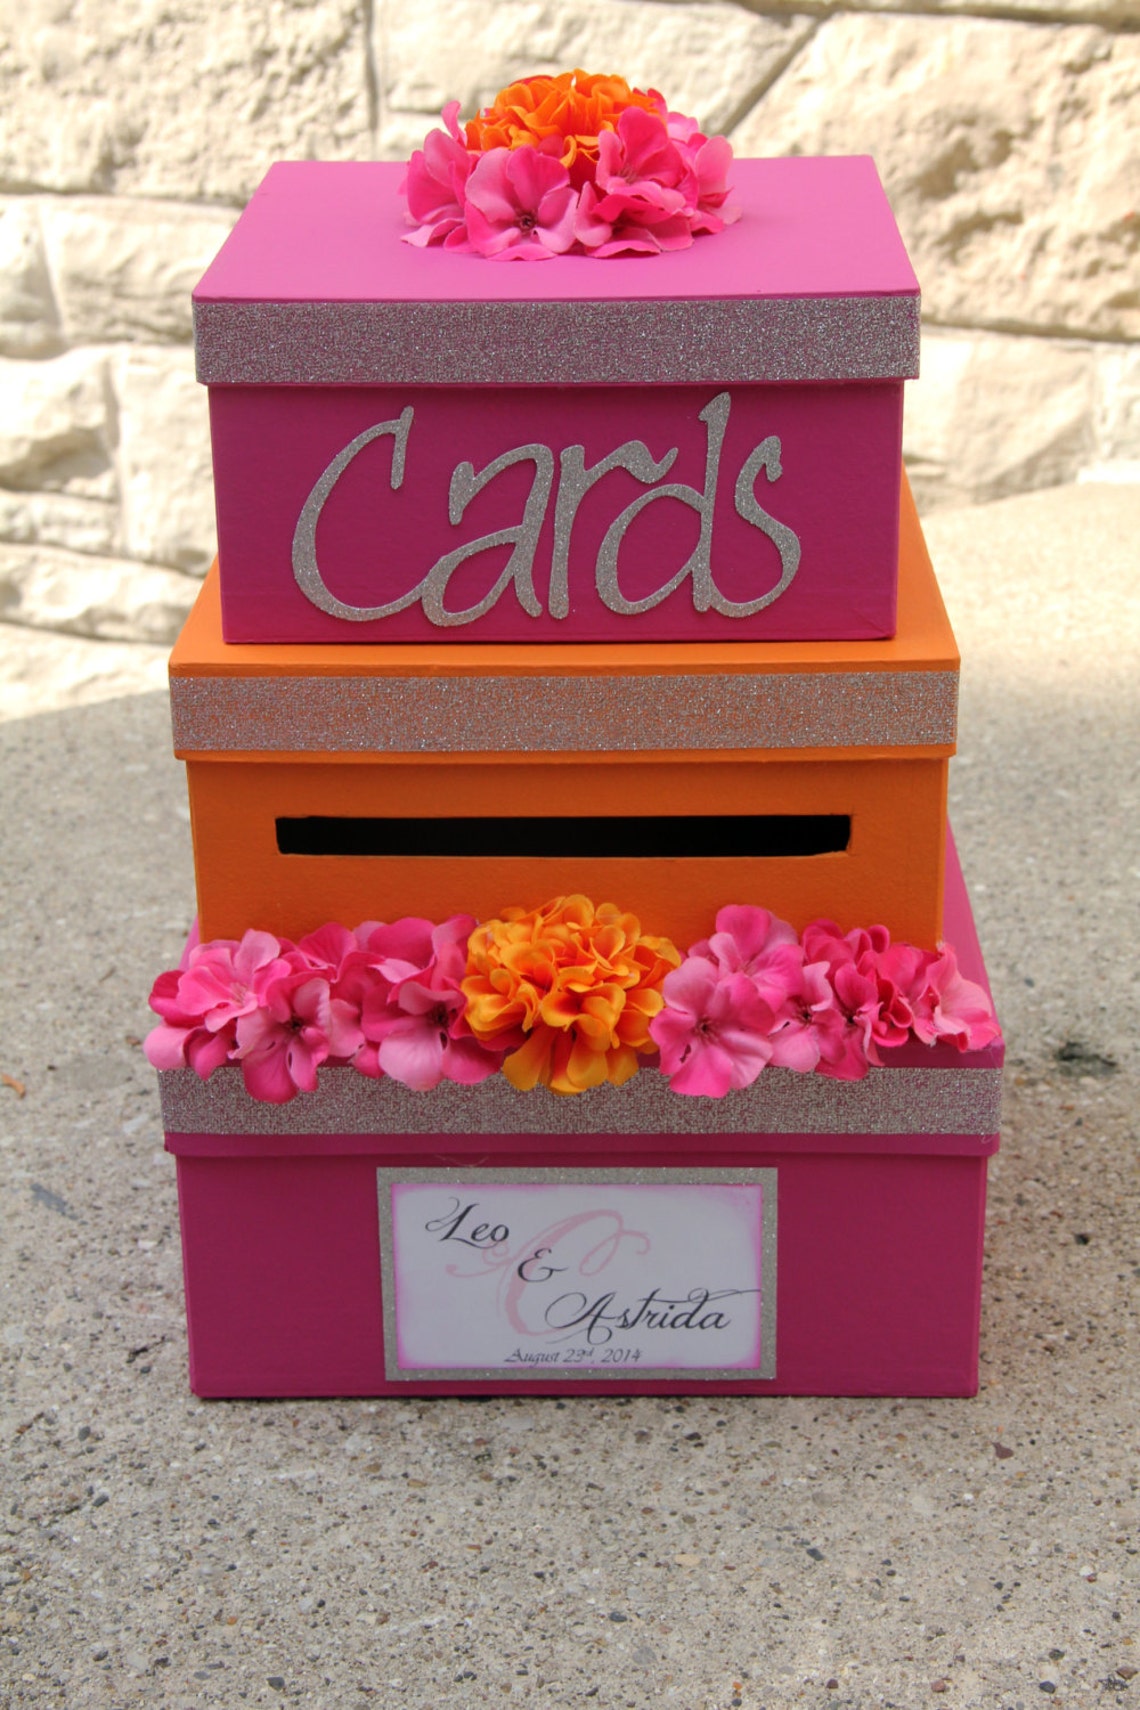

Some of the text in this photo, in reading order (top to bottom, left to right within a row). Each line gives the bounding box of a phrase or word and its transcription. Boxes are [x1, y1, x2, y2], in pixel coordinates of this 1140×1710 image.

[292, 392, 801, 627] Cards
[425, 1197, 510, 1250] Leo
[517, 1248, 568, 1283] &
[544, 1287, 761, 1346] Astrida
[504, 1347, 560, 1368] August
[601, 1348, 643, 1363] 2014
